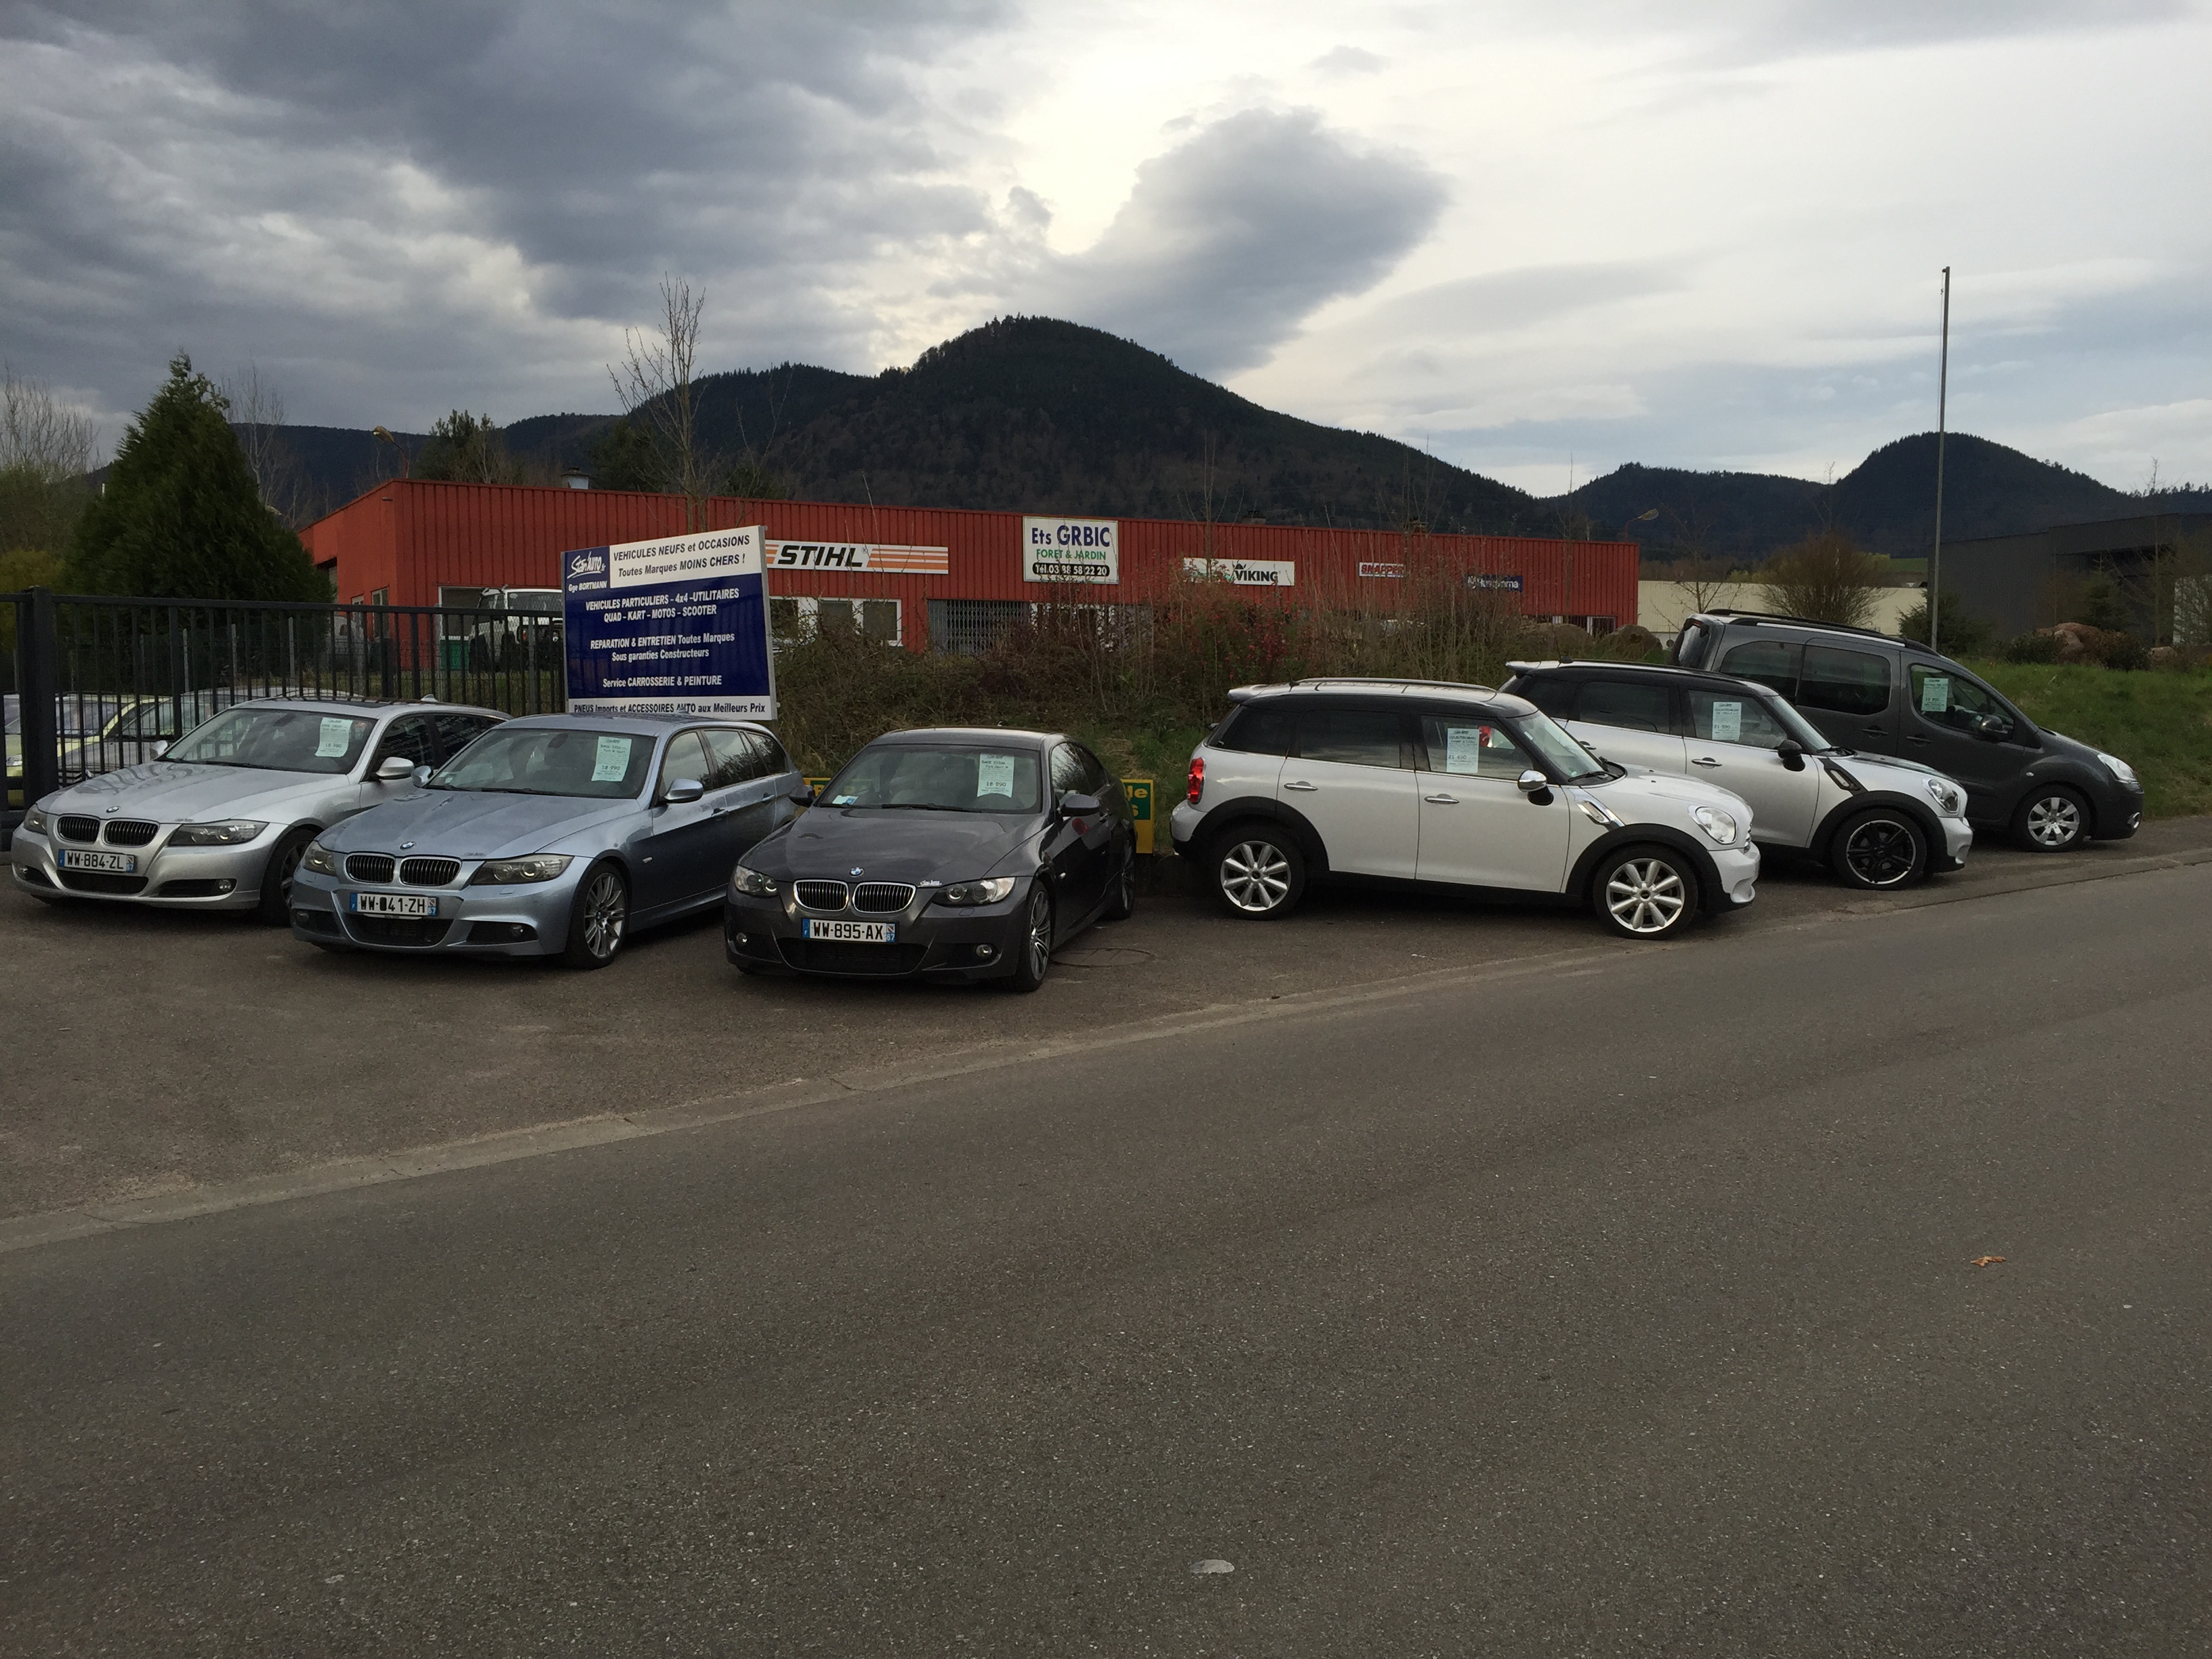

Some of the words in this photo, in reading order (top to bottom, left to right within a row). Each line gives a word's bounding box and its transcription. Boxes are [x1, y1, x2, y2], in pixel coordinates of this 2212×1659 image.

[1031, 527, 1052, 545] Ets
[1057, 525, 1110, 547] GRBIC
[613, 547, 656, 561] VEHICULES
[659, 543, 685, 556] NEUFS
[687, 542, 696, 552] et
[698, 535, 750, 550] OCCASIONS
[1065, 550, 1071, 558] &
[1074, 550, 1106, 560] JARDIN
[777, 545, 863, 567] STIHL
[618, 567, 642, 577] Toutes
[644, 563, 678, 575] Marques
[680, 558, 708, 570] MOINS
[710, 554, 740, 567] CHERS
[1073, 565, 1083, 575] 58
[1085, 566, 1095, 575] 22
[1097, 566, 1107, 575] 20
[1234, 570, 1278, 582] VIKING
[579, 581, 607, 591] BORTMANN
[586, 598, 621, 611] VEHICULES
[621, 594, 669, 608] PARTICULIERS
[675, 592, 688, 603] 4x4
[604, 612, 622, 623] QUAD
[628, 610, 646, 621] KART
[651, 608, 676, 619] MOTOS
[682, 605, 717, 617] SCOOTER
[590, 638, 630, 649] REPARATION
[631, 637, 636, 647] &
[638, 635, 676, 647] ENTRETIEN
[678, 634, 701, 644] Toutes
[703, 632, 735, 644] Marques
[612, 652, 627, 661] Sous
[628, 651, 659, 663] garanties
[660, 649, 710, 659] Constructeurs
[602, 678, 627, 688] Service
[628, 676, 675, 687] CARROSSERIE
[676, 676, 682, 686] &
[684, 675, 722, 686] PEINTURE
[574, 704, 594, 712] PNEUS
[628, 703, 674, 713] ACCESSOIRES
[698, 705, 712, 713] aux
[713, 703, 747, 713] Meilleurs
[750, 703, 766, 713] Prix
